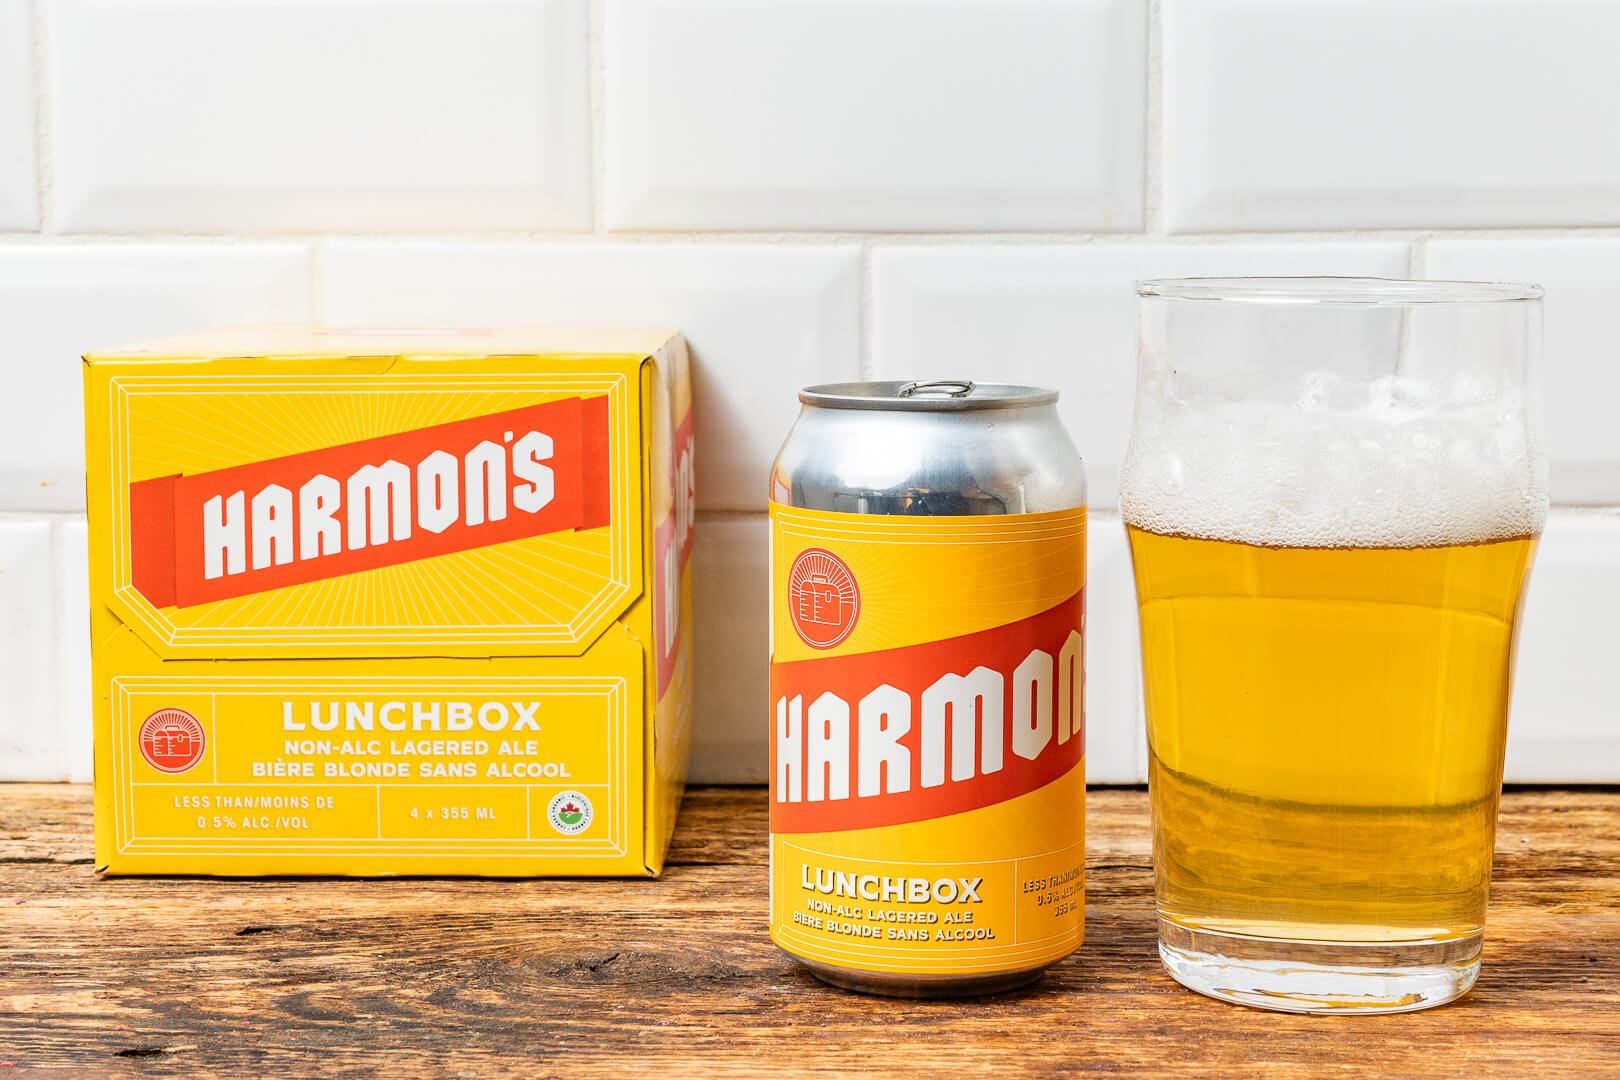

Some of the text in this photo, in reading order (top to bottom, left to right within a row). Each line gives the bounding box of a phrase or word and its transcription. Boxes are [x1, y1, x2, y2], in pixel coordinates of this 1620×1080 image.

[204, 430, 555, 580] HARMON'S
[282, 701, 542, 732] LUNCHBOX
[284, 739, 539, 756] NON-ALC LAGERED ALE
[253, 757, 572, 778] BIÈRE BLONDE SANS ALCOOL
[174, 795, 334, 810] LESS THAN/MOINS DE
[410, 806, 419, 820] 4
[440, 806, 469, 820] 355
[476, 806, 497, 820] ML
[197, 816, 236, 829] 0.5%
[801, 863, 983, 904] LUNCHBOX
[1023, 877, 1047, 893] LESS
[807, 898, 974, 925] NON-ALC LAGERED ALE
[827, 921, 883, 939] BLONDE
[887, 927, 929, 942] SANS
[935, 927, 996, 942] ALCOOL
